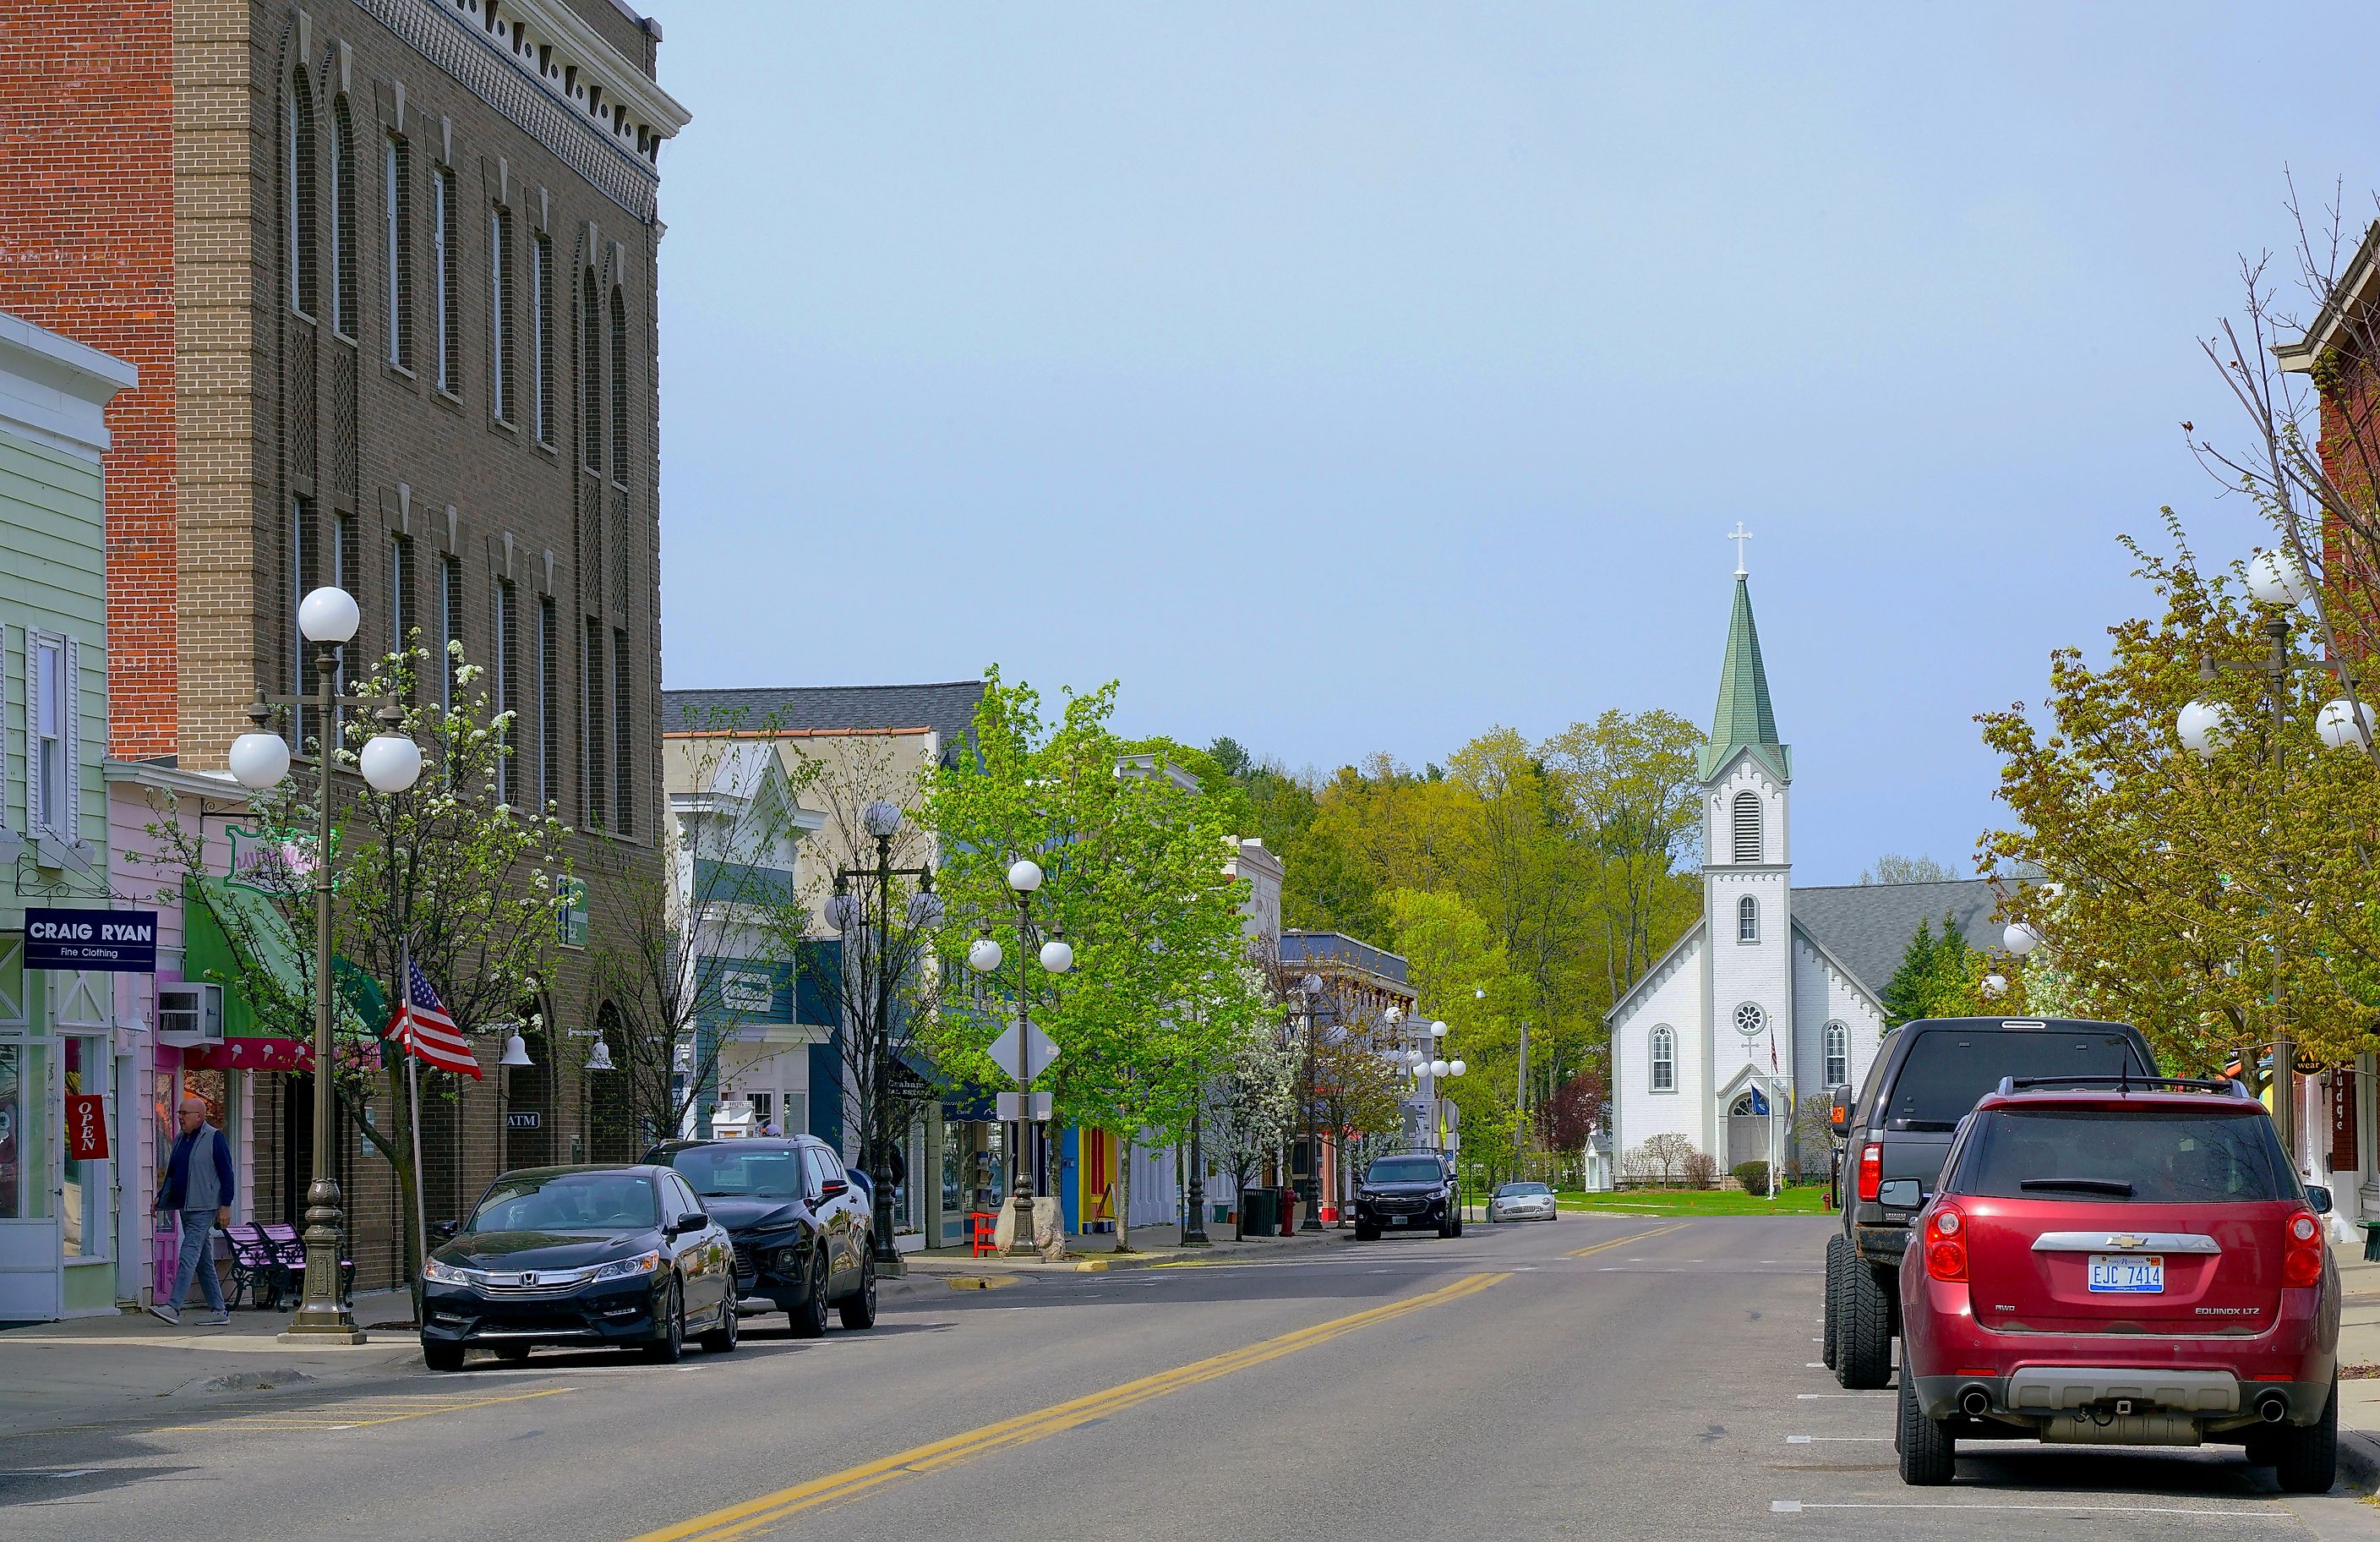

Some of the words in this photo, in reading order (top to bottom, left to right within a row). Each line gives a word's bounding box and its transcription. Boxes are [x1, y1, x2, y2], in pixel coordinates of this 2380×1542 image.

[30, 922, 93, 940] CRAIG
[101, 925, 151, 942] RYAN
[61, 948, 79, 956] Fine
[81, 949, 118, 959] Clothing
[79, 1102, 96, 1151] OPEN
[507, 1115, 536, 1126] ATM
[2093, 1266, 2119, 1284] EJC
[2127, 1266, 2160, 1284] 7414
